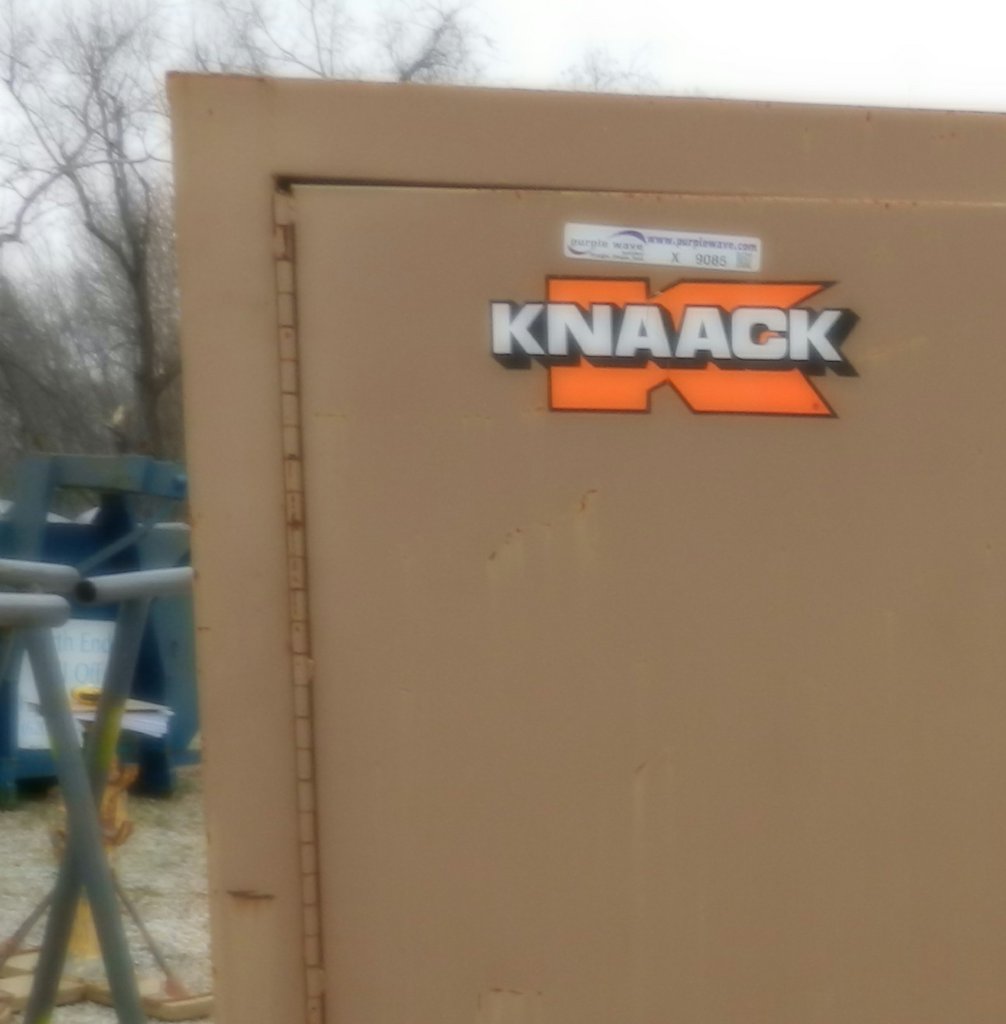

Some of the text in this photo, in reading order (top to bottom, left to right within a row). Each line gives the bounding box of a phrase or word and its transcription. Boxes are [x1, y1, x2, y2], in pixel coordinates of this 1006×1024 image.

[612, 240, 643, 250] wave
[647, 235, 758, 252] www.purplewave.com
[671, 252, 728, 267] X 9085
[490, 301, 848, 367] KNAACK
